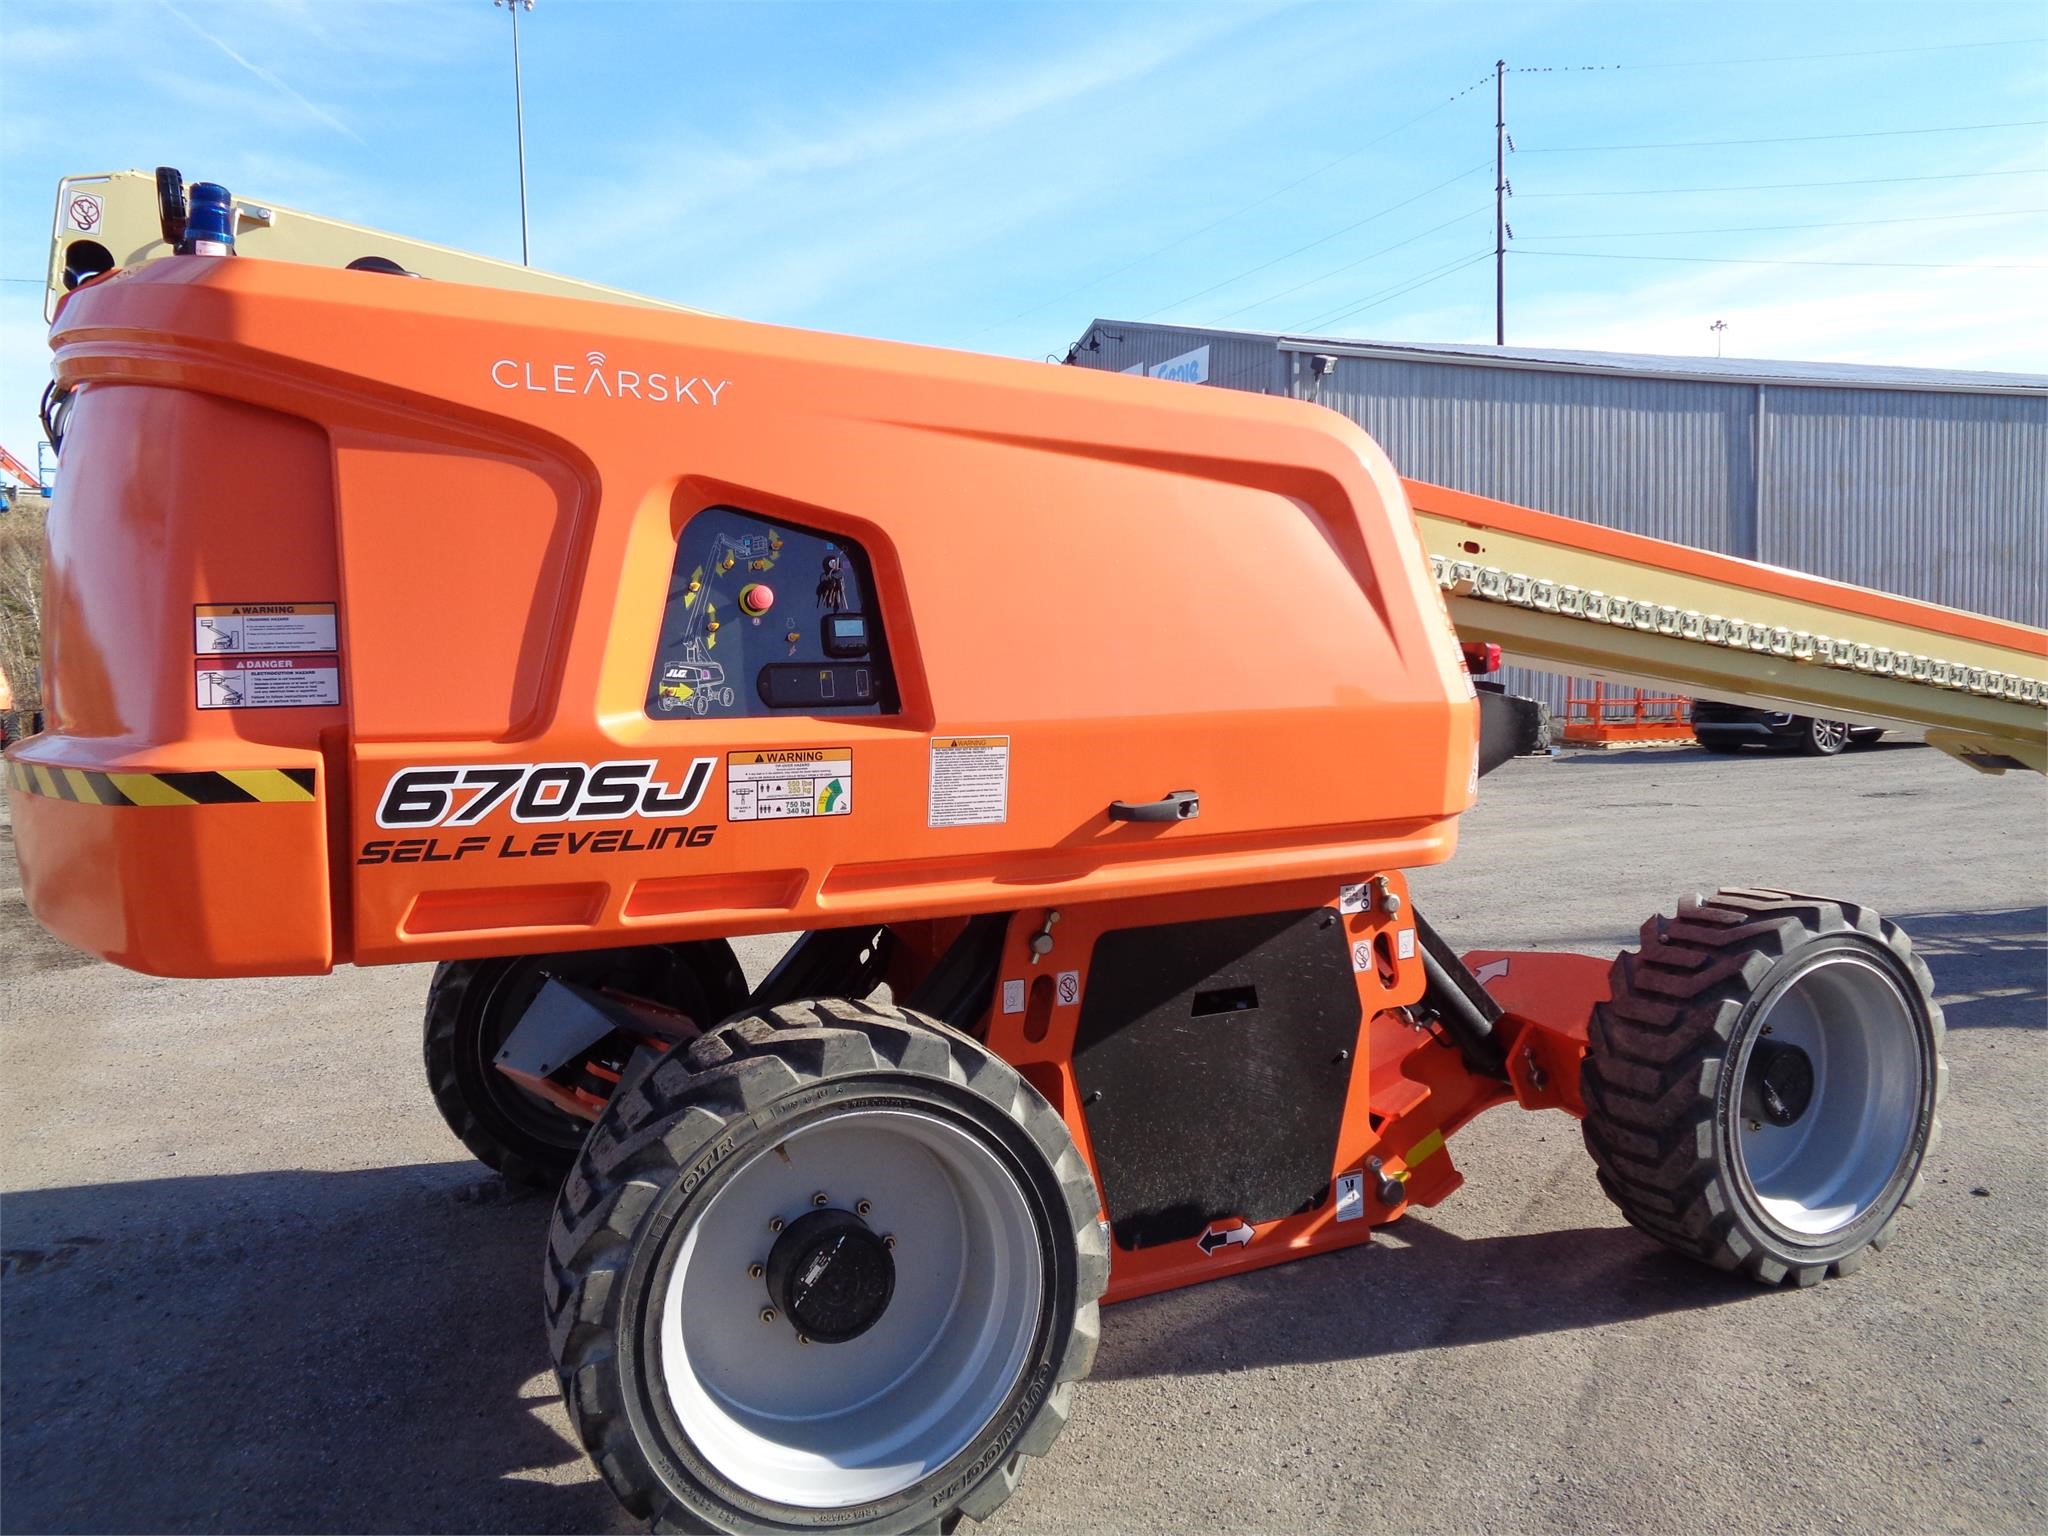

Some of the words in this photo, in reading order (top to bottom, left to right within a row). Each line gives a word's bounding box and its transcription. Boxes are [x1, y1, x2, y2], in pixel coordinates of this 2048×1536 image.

[242, 606, 295, 614] WARNING
[247, 660, 293, 669] DANGER
[666, 669, 688, 678] JLG
[958, 739, 987, 747] WARNING
[767, 751, 823, 762] WARNING
[375, 757, 718, 830] 670SJ
[803, 786, 811, 794] kg
[356, 837, 491, 865] SELF
[498, 825, 718, 859] LEVELING
[680, 1136, 735, 1195] OTR
